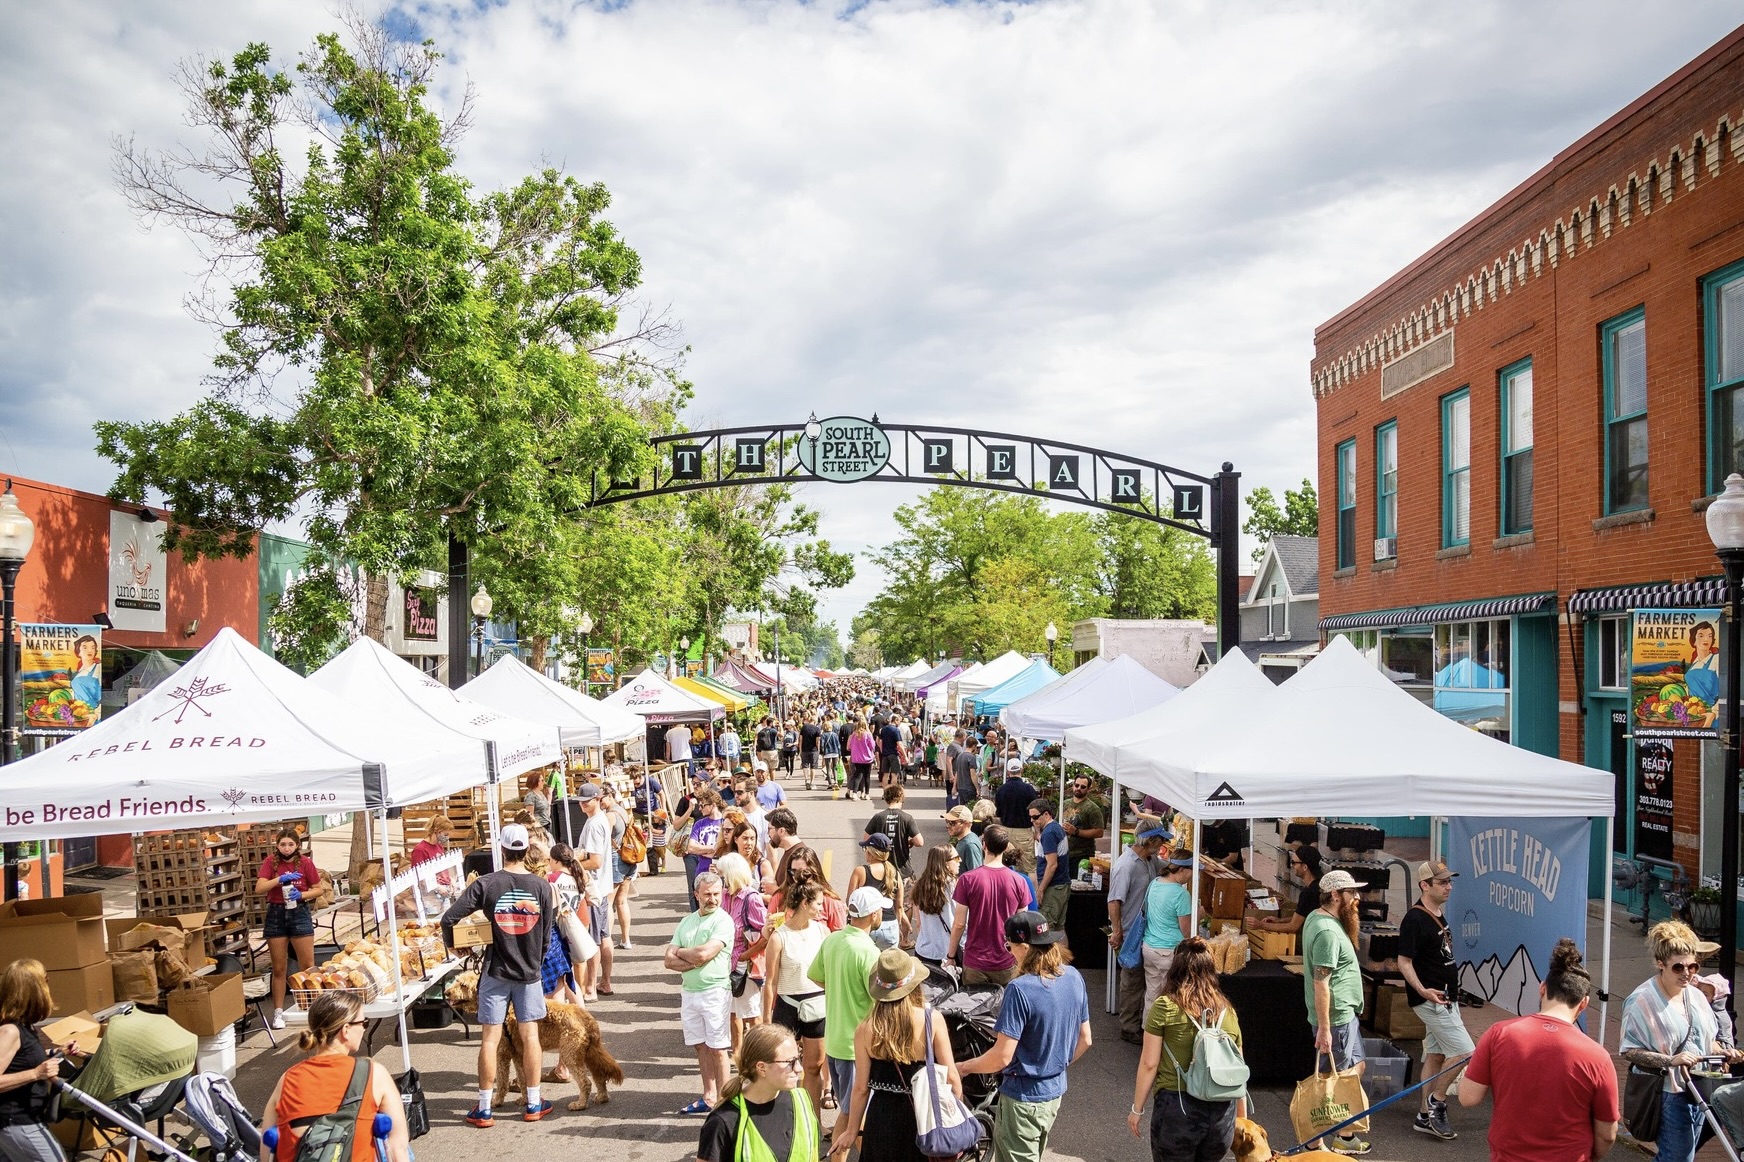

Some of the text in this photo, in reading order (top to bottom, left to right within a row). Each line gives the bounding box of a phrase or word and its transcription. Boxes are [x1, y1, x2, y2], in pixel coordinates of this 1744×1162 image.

[826, 427, 874, 440] SOUTH
[822, 441, 886, 466] PEARL
[822, 461, 869, 474] STREET
[929, 444, 1200, 513] PEARL
[116, 585, 160, 600] uno mas
[409, 608, 436, 635] Pizza
[1638, 613, 1696, 625] FARMERS
[25, 626, 79, 638] FARMERS
[1638, 627, 1686, 639] MARKET
[25, 640, 71, 651] MARKET
[1612, 713, 1627, 723] 1592
[1635, 729, 1717, 738] southpearlstreet.com
[67, 736, 266, 762] REBEL BREAD
[1642, 757, 1672, 772] REALTY
[251, 793, 336, 804] REBEL BREAD
[1639, 795, 1673, 809] 303.778.0123
[6, 795, 212, 826] be Bread Friends.
[1641, 821, 1669, 833] REAL ESTATE
[1470, 828, 1562, 902] KETTLE HEAD
[1489, 880, 1535, 918] POPCORN
[1310, 1103, 1350, 1117] SUNFLOWER
